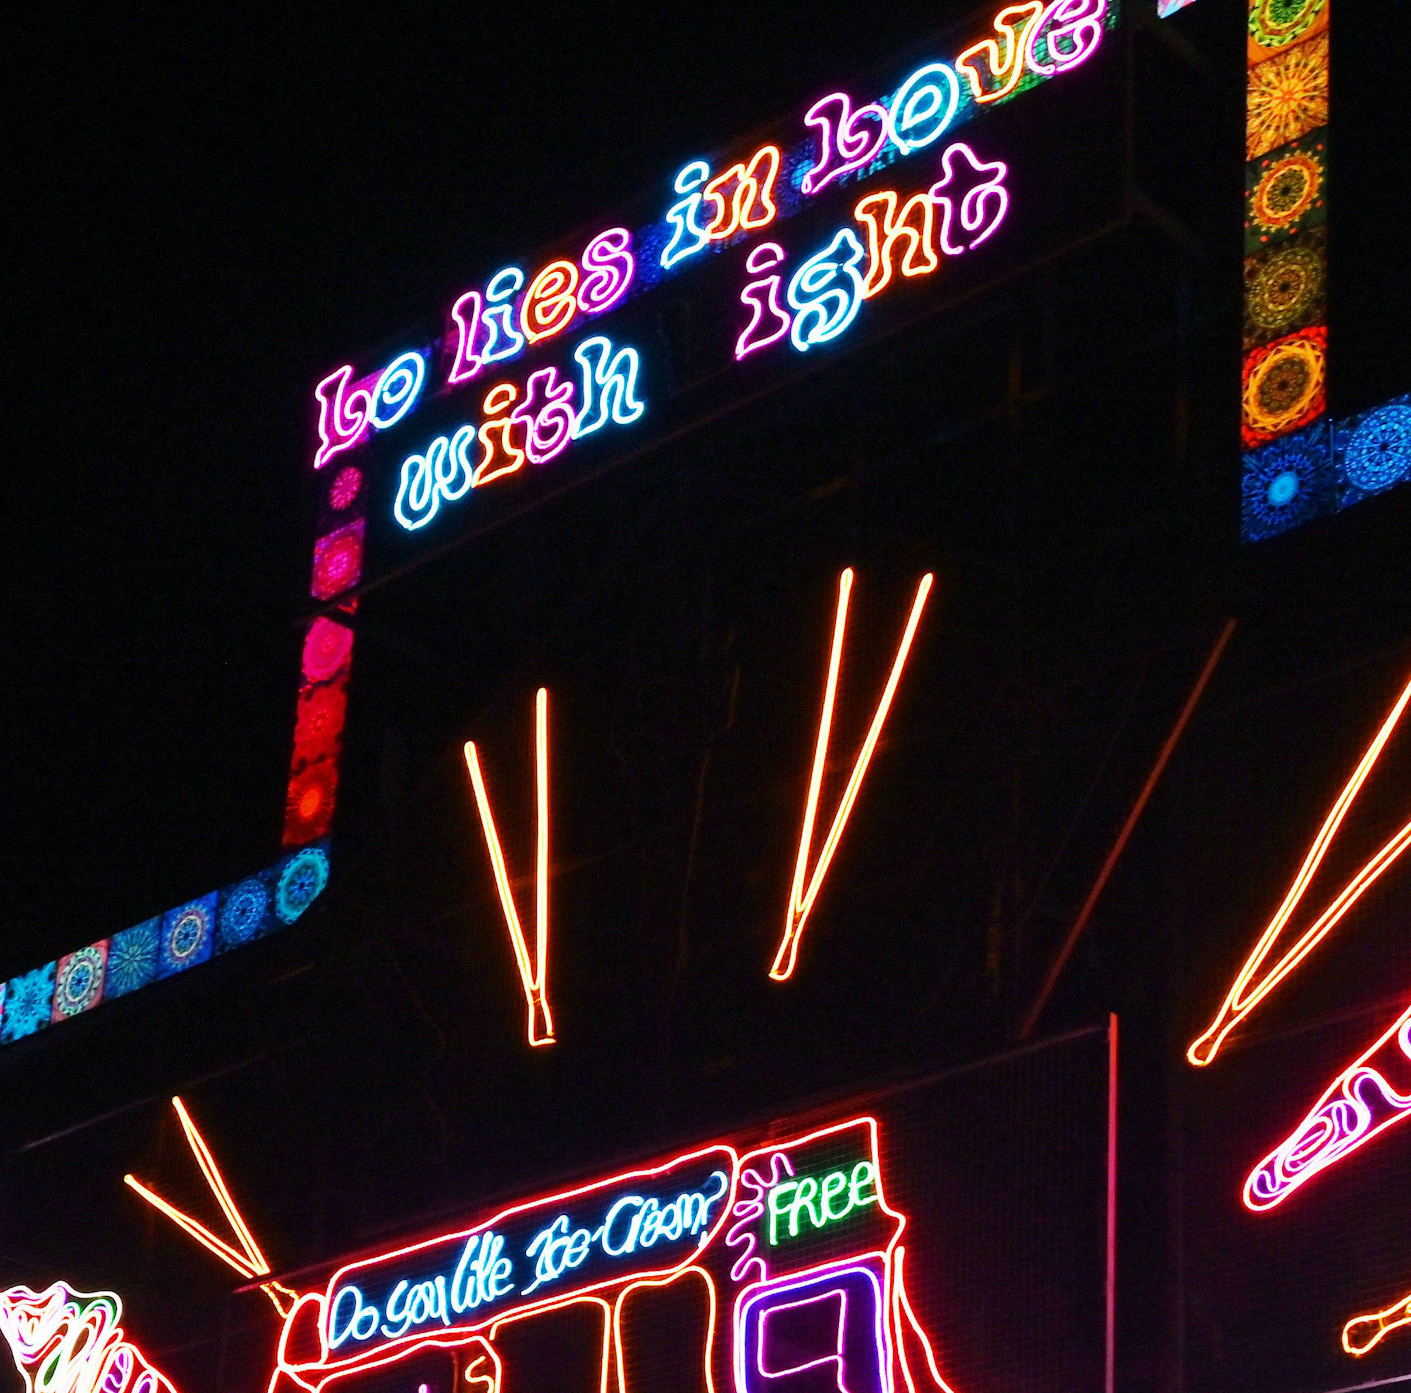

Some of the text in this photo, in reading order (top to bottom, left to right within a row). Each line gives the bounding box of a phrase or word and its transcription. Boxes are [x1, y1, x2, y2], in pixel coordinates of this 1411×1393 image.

[448, 226, 636, 385] lies
[661, 145, 782, 269] in
[802, 0, 1107, 195] Love
[393, 336, 645, 531] with
[328, 1285, 380, 1350] Do
[381, 1274, 451, 1339] you
